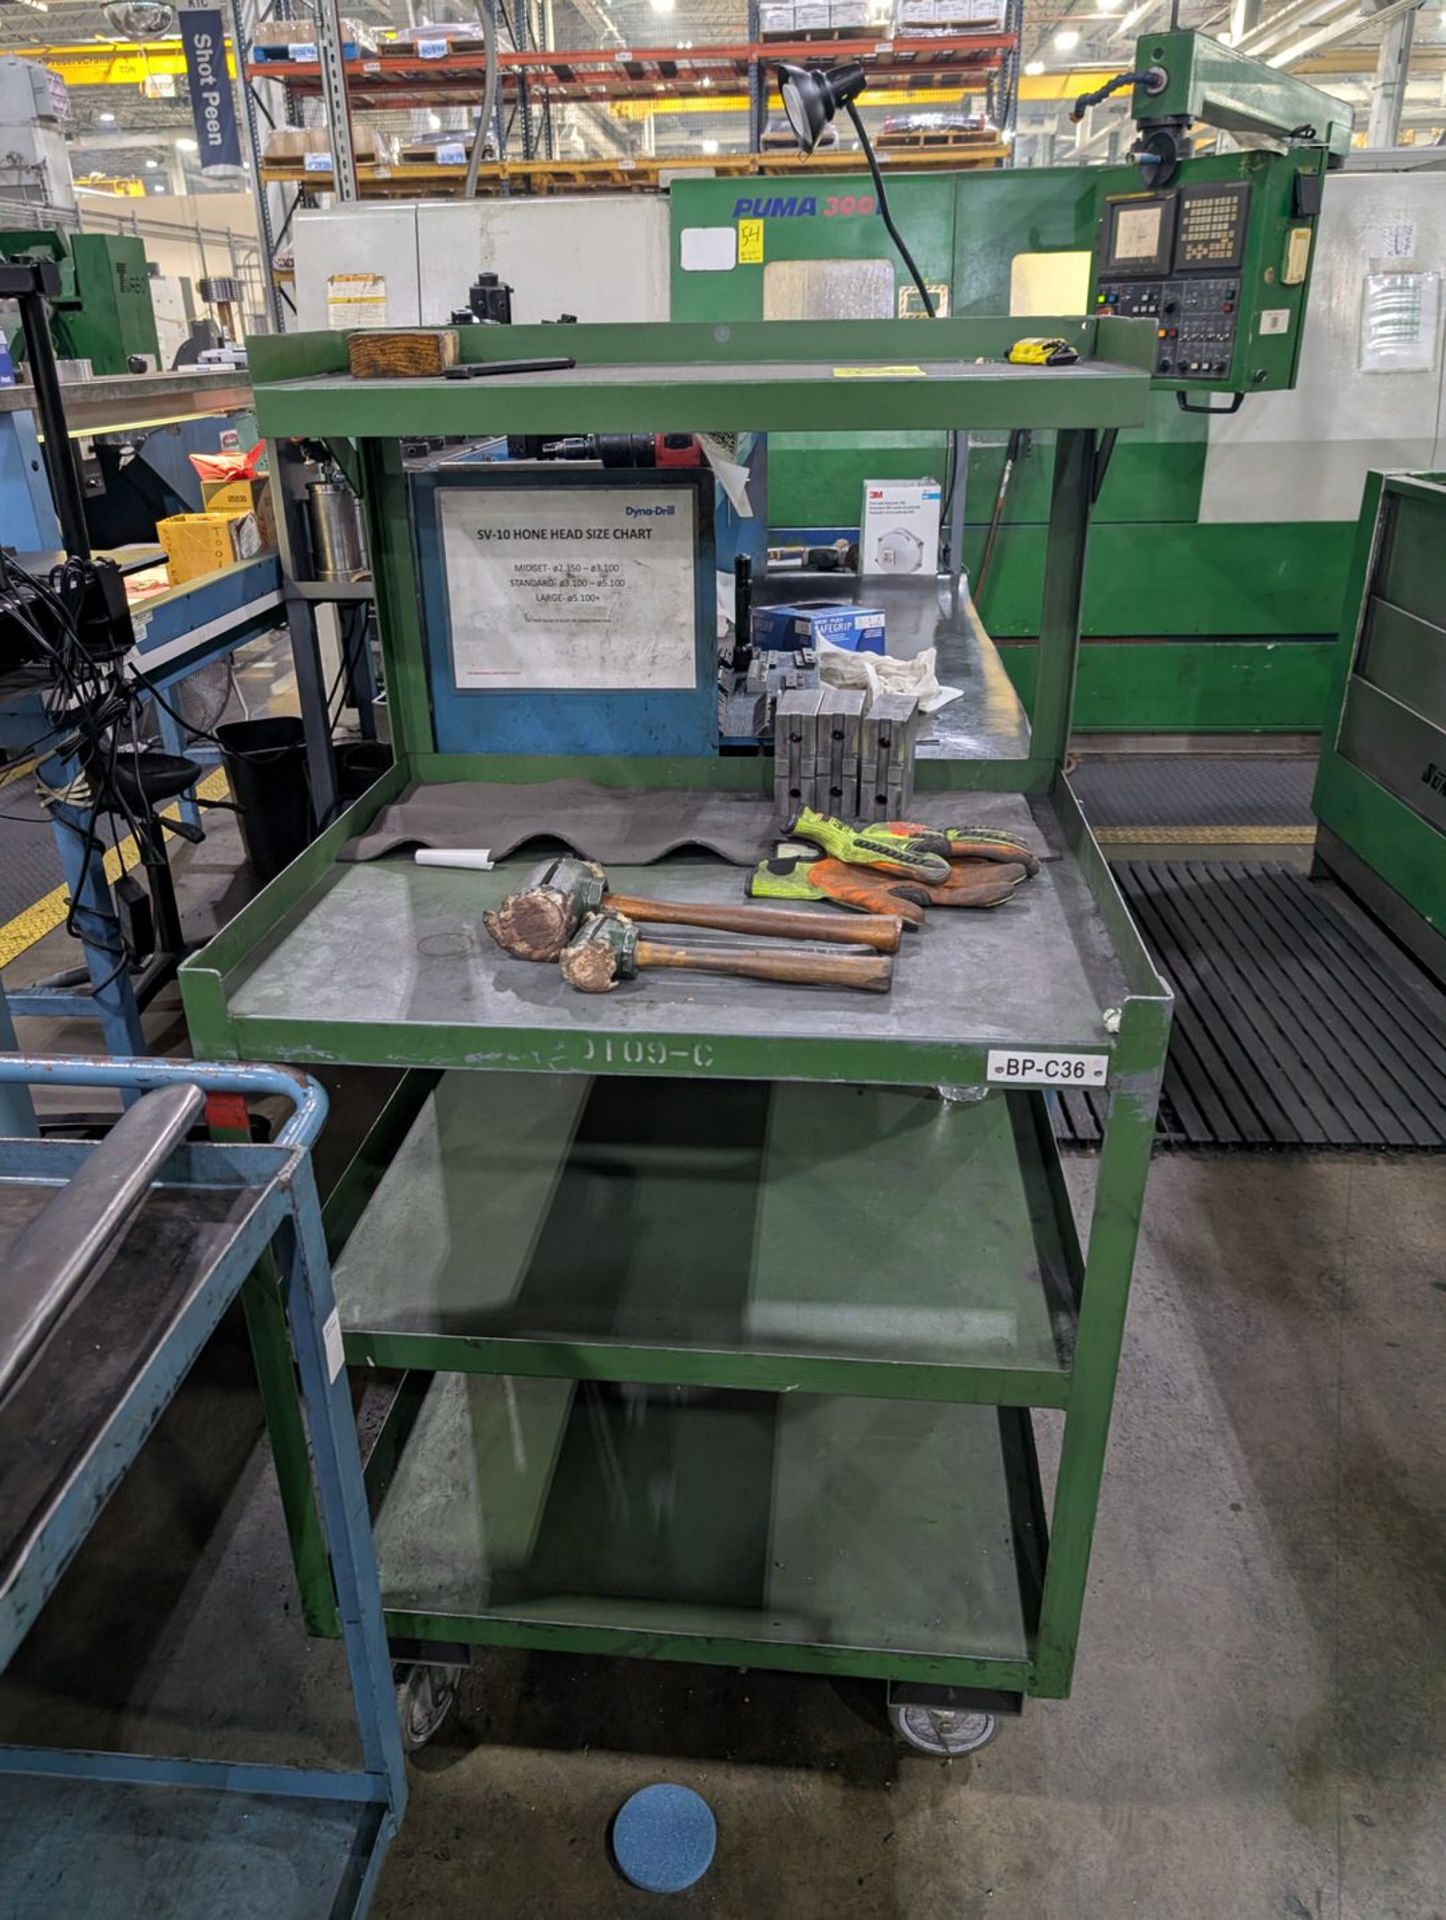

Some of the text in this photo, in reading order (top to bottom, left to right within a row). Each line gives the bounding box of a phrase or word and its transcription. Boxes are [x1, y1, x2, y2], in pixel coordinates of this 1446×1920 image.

[193, 33, 222, 146] Shot Peen
[732, 196, 816, 218] PUMA
[869, 491, 884, 499] 3M
[476, 528, 653, 541] SV-10 HONE HEAD SIZE CHART
[1006, 1058, 1086, 1079] BP-C36
